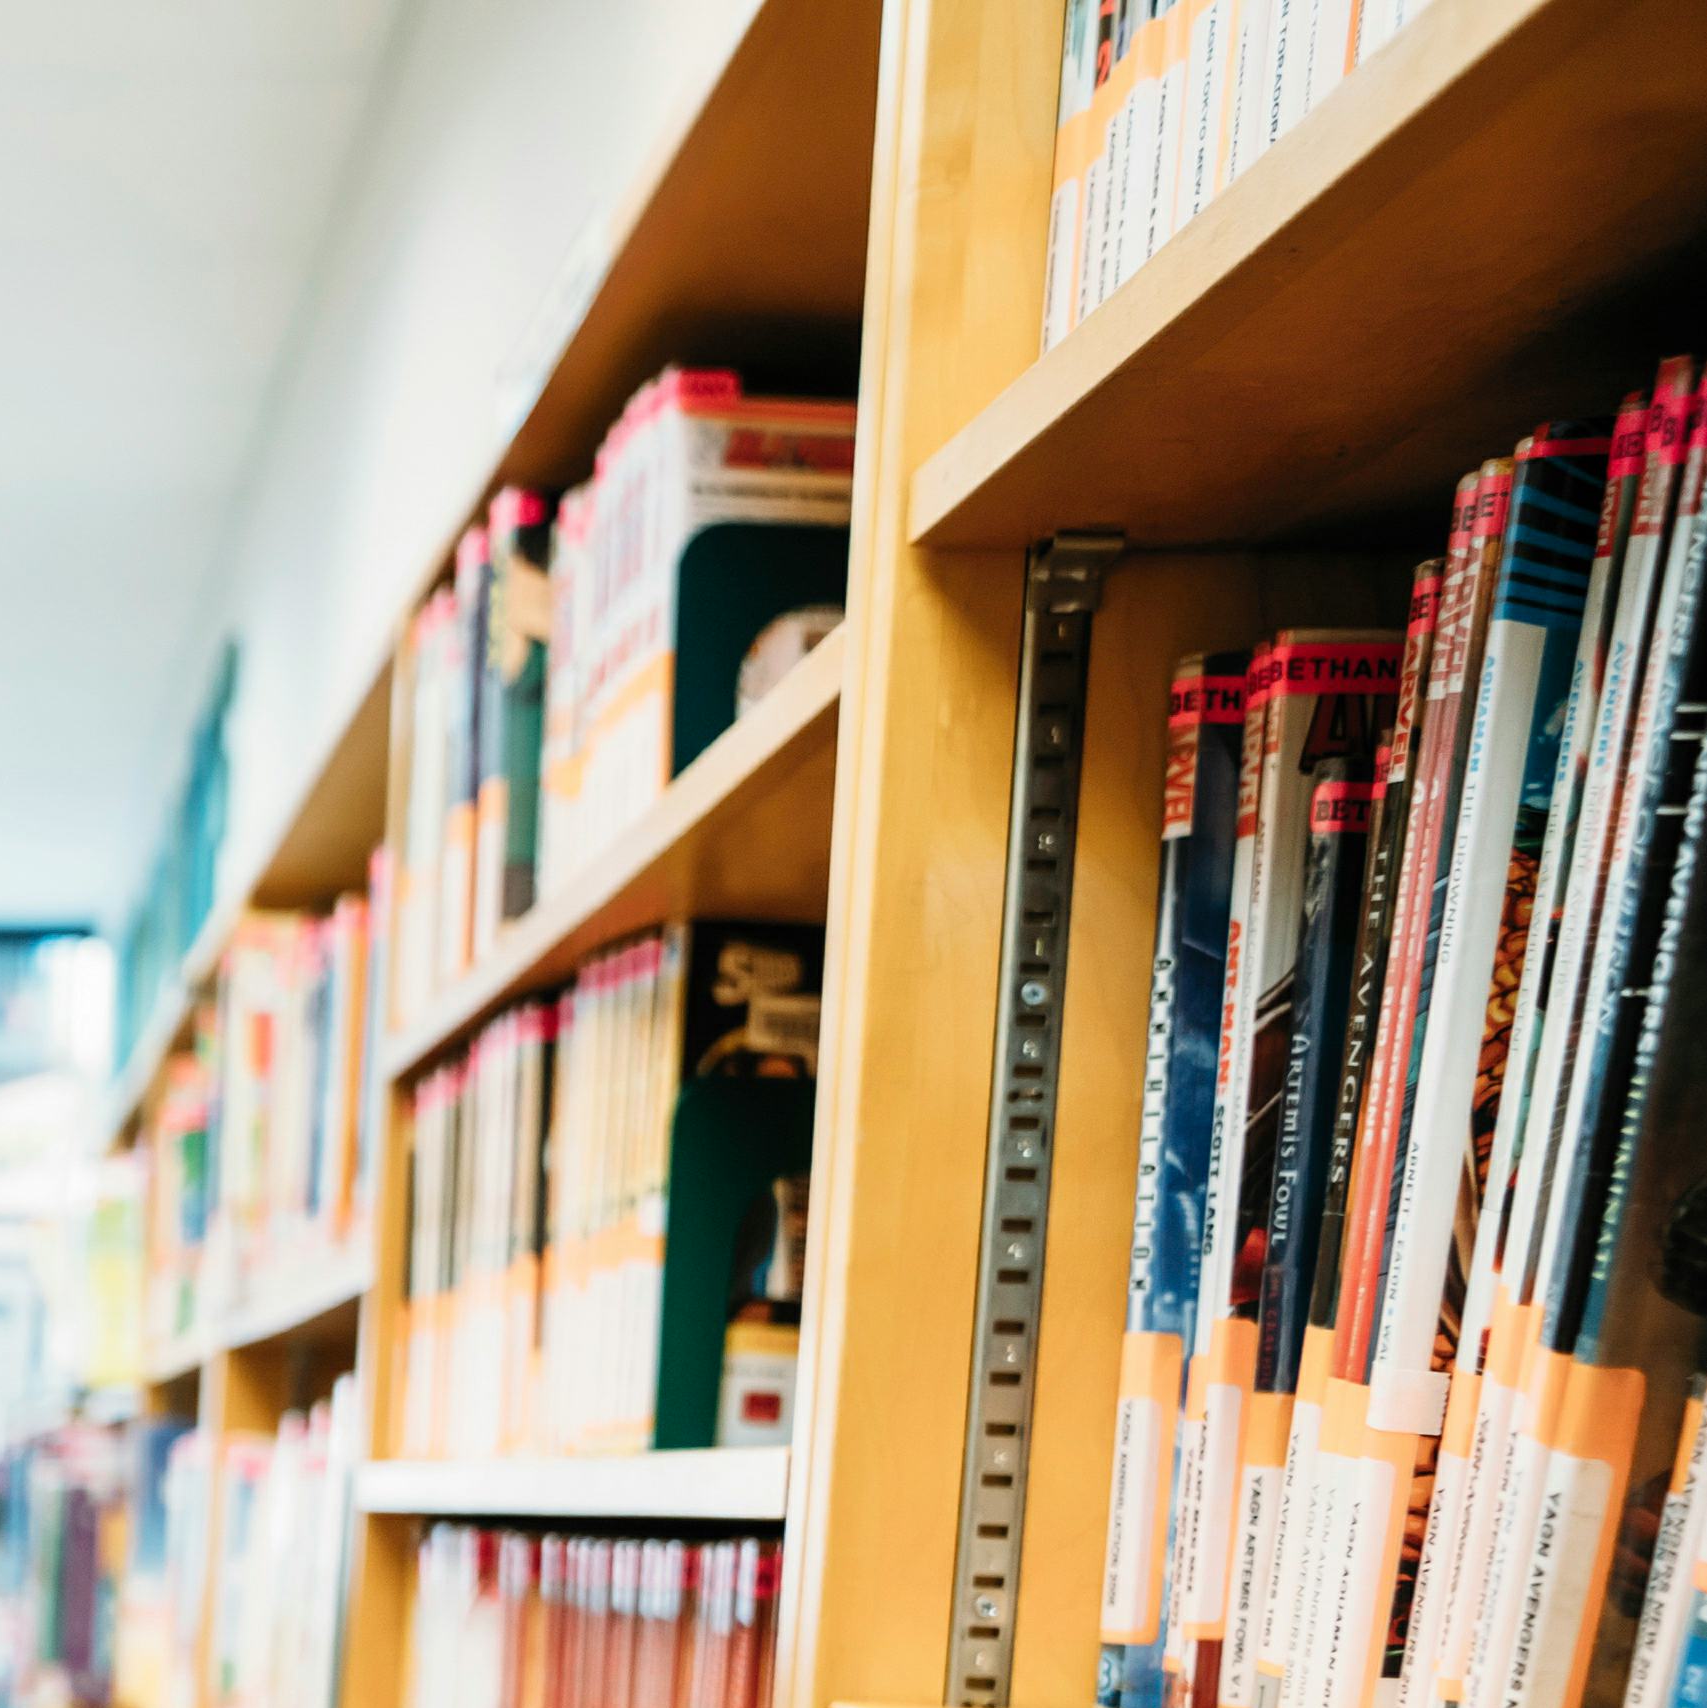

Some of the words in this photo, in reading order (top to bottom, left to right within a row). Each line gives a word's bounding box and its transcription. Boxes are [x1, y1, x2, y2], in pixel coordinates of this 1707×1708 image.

[1206, 7, 1217, 62] YAGN
[1199, 70, 1211, 139] TOKYO
[1193, 147, 1204, 195] MEW
[1389, 640, 1422, 769] ARVEL
[1467, 655, 1497, 772] AQUAMAN
[1557, 660, 1583, 781] AVENGERS
[1596, 642, 1625, 766] AVENGERS
[1163, 720, 1200, 826] ARVEL
[1460, 784, 1476, 825] THE
[1366, 850, 1390, 928] THE
[1437, 835, 1469, 964] DROWNING
[1329, 952, 1376, 1182] AVENGERS
[1133, 957, 1172, 1293] ANNIHILATION
[1207, 1105, 1226, 1177] SCOTT
[1402, 1142, 1419, 1213] ABNETT
[1201, 1192, 1218, 1255] LANG
[1388, 1240, 1404, 1299] EATON
[1286, 1433, 1298, 1486] YAGN
[1247, 1476, 1262, 1525] YAGN
[1345, 1502, 1360, 1558] YAGN
[1427, 1488, 1445, 1544] YAGN
[1536, 1492, 1562, 1557] YAGN
[1238, 1533, 1256, 1610] ARTEMIS
[1270, 1494, 1290, 1598] AVENGERS
[1288, 1546, 1310, 1650] AVENGERS
[1327, 1566, 1350, 1668] AQUAMAN
[1404, 1554, 1433, 1665] AVENGERS
[1509, 1565, 1546, 1690] AVENGERS
[1232, 1618, 1246, 1666] FOWL
